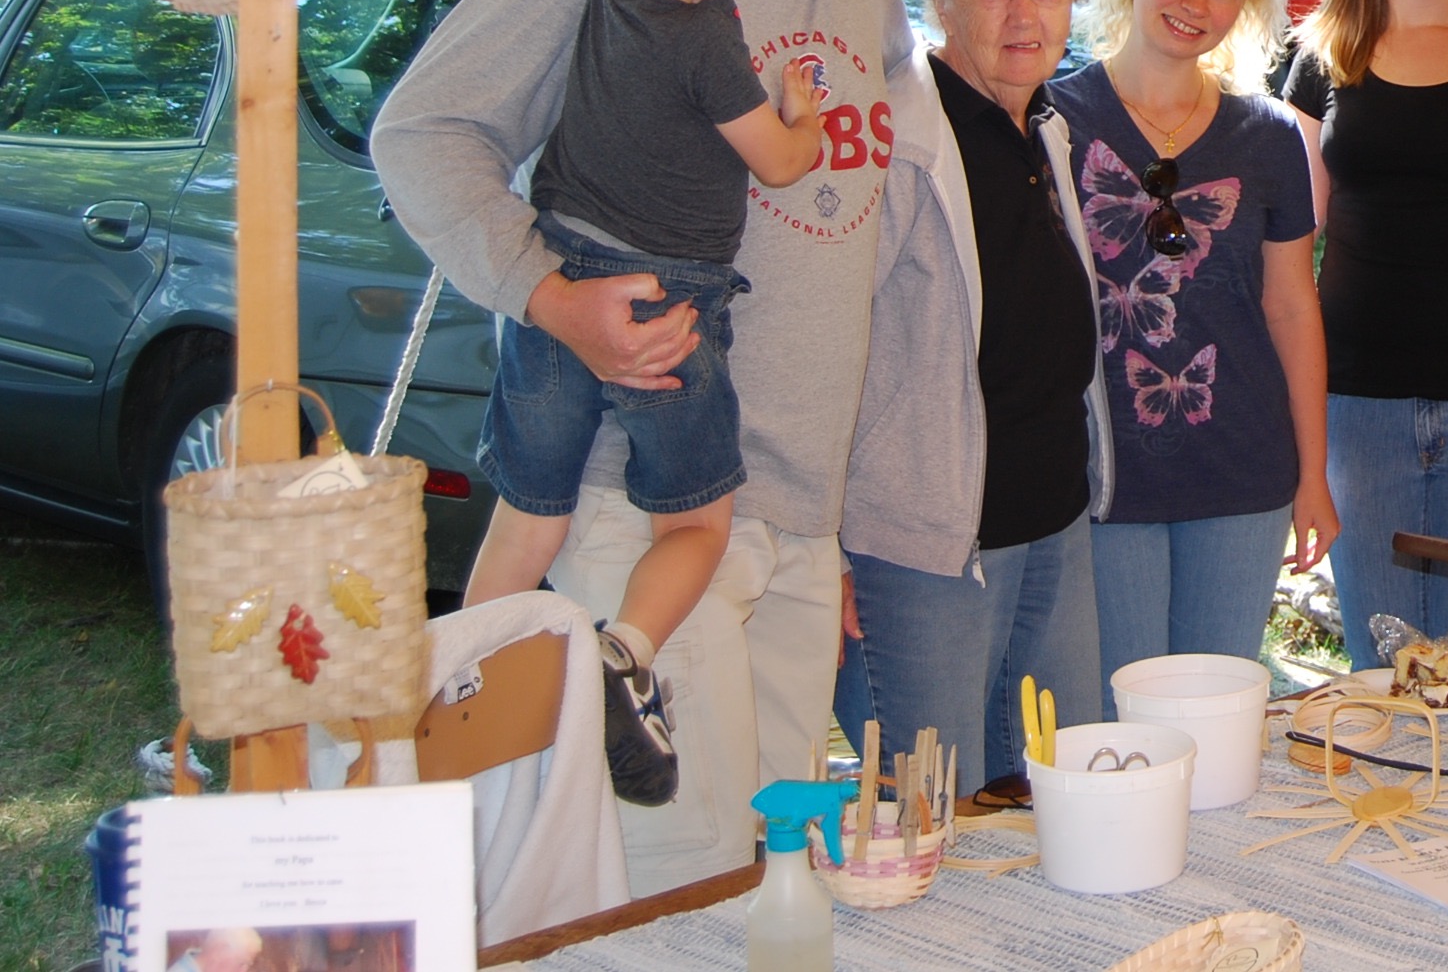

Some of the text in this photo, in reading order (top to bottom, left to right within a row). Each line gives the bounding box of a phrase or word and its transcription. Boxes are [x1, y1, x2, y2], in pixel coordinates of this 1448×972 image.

[752, 31, 867, 74] CHICAGO
[779, 101, 895, 172] BS
[747, 182, 881, 238] NATIONAL LEAGUE
